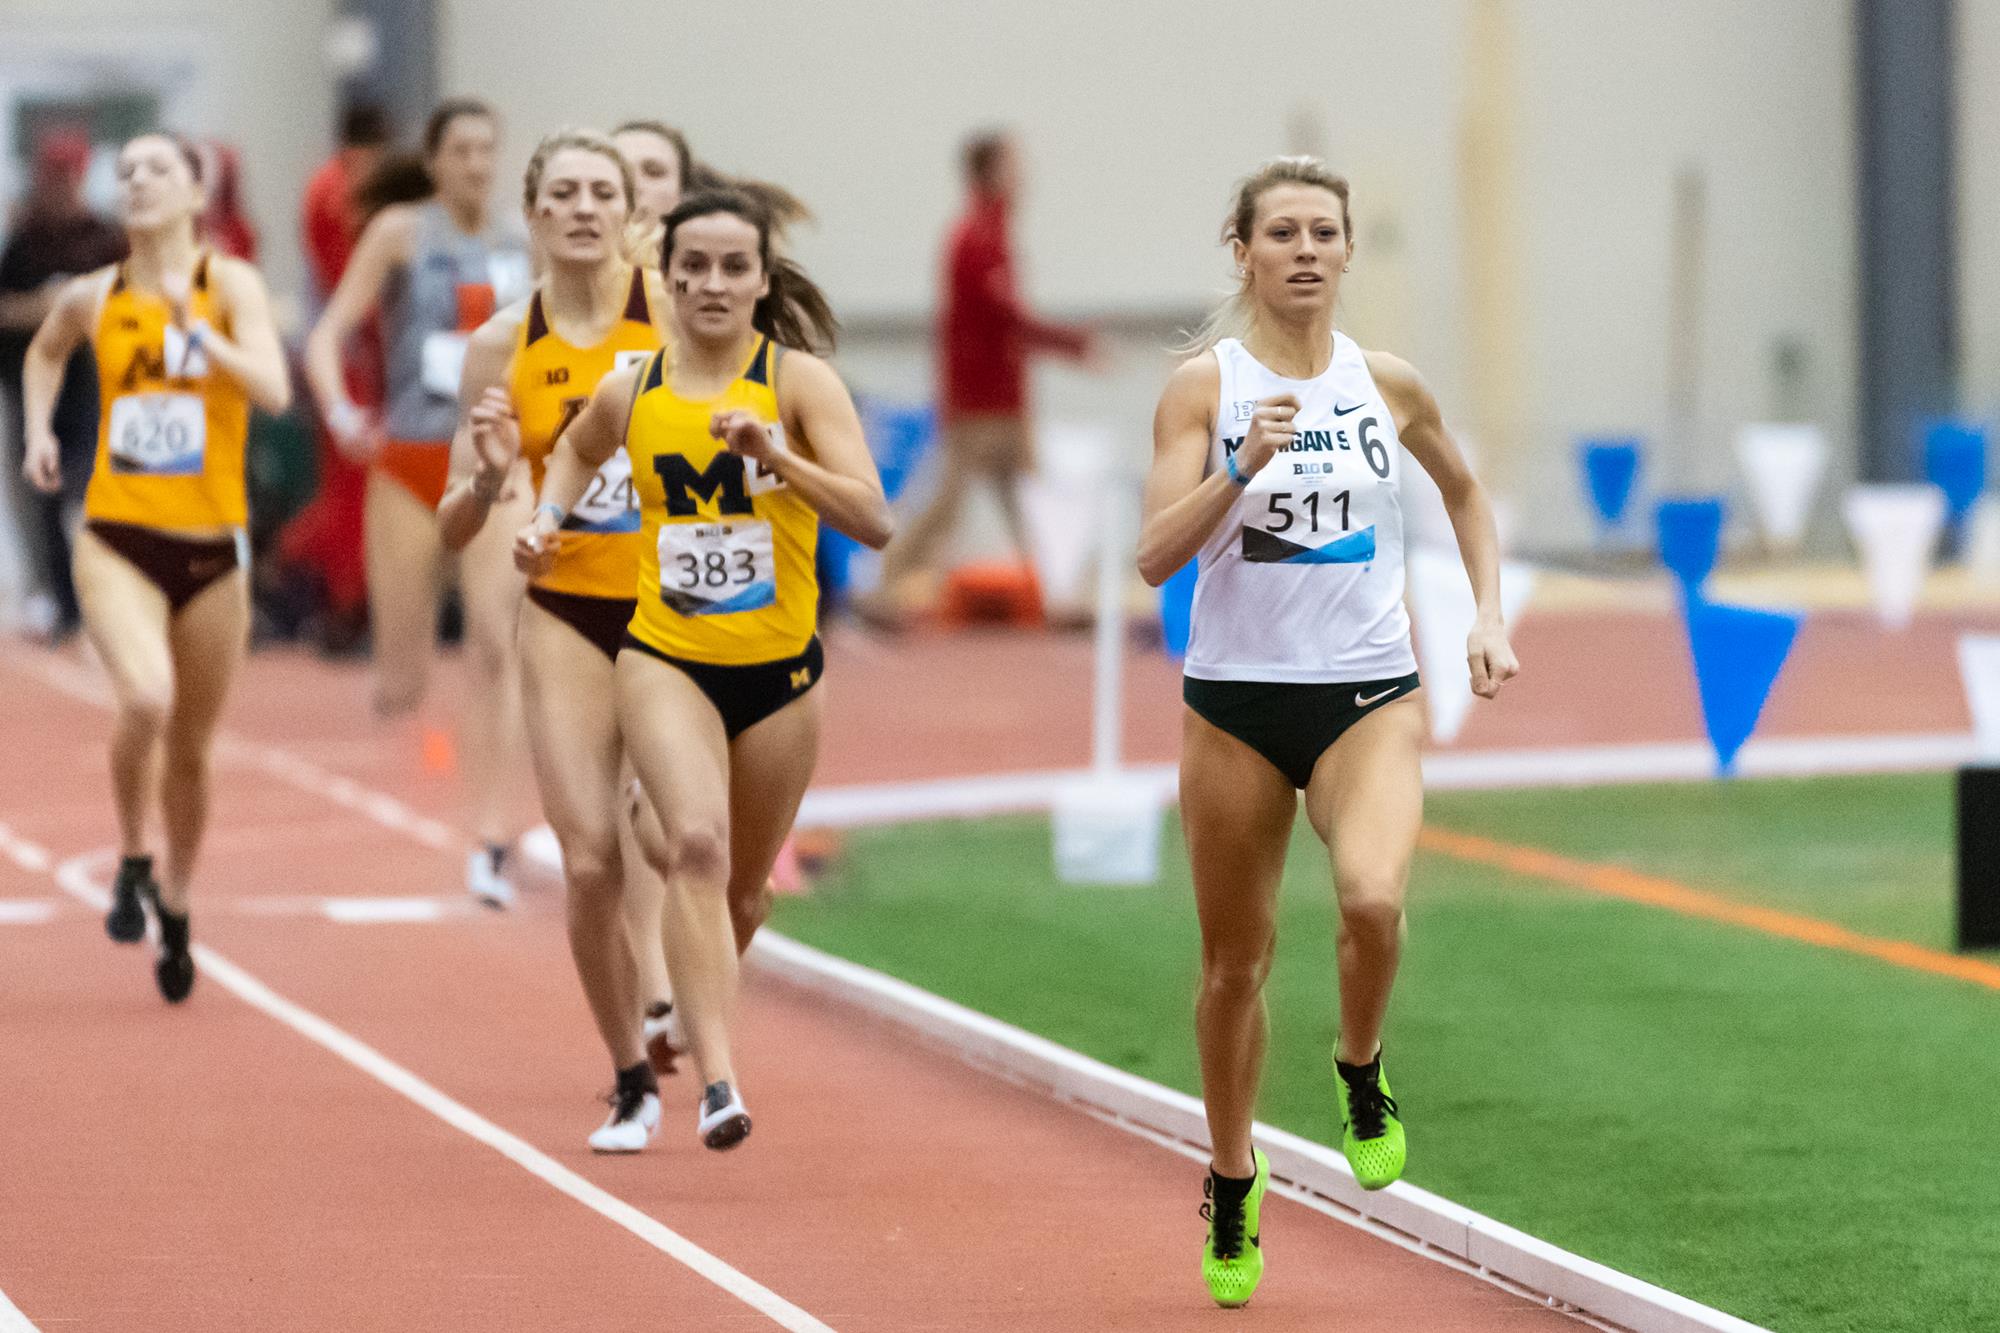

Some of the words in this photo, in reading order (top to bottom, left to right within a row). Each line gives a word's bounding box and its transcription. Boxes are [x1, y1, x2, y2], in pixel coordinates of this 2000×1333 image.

[1358, 416, 1390, 479] 6
[653, 450, 755, 517] M
[1265, 489, 1351, 533] 511
[675, 549, 756, 589] 383
[790, 666, 810, 689] M
